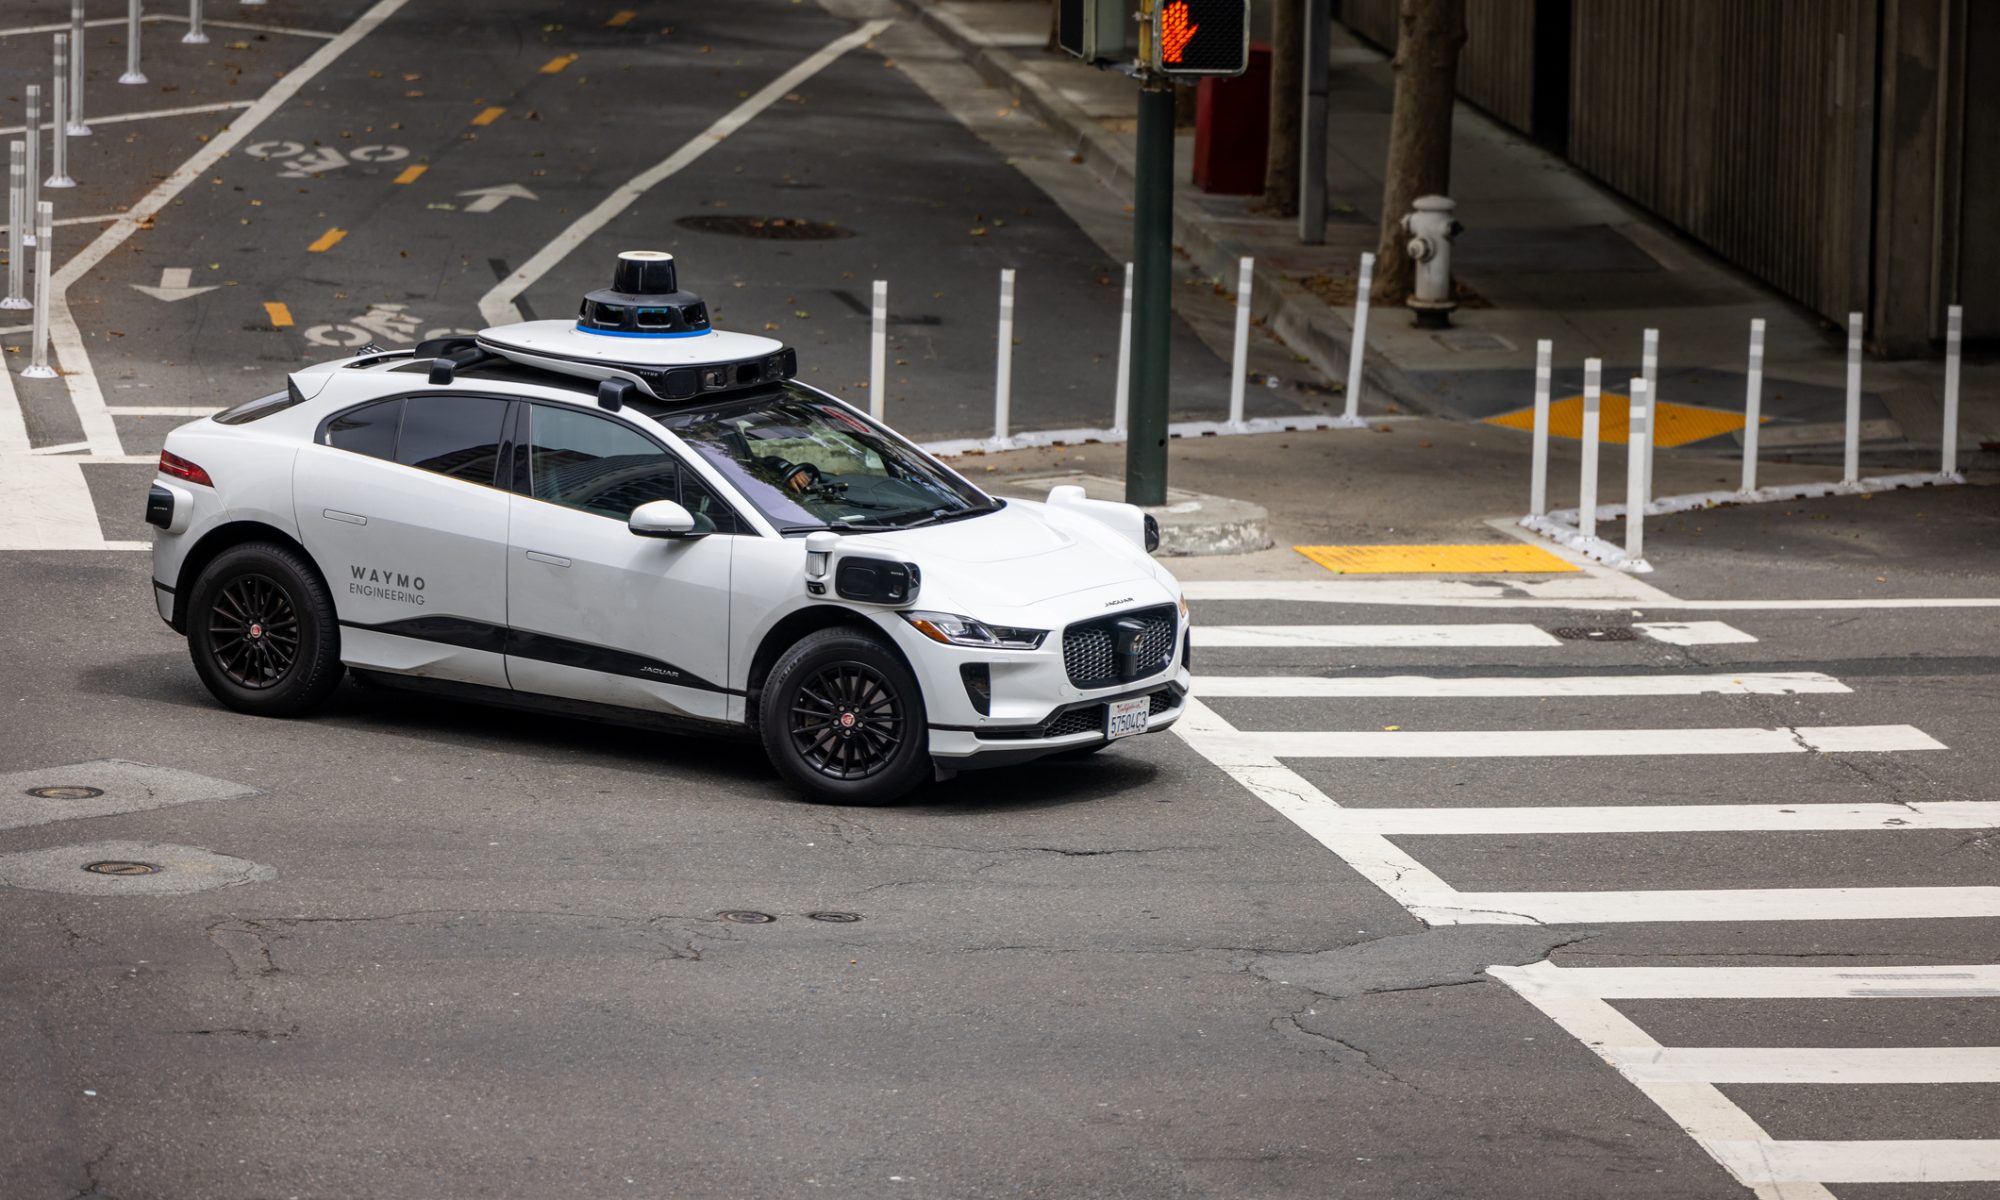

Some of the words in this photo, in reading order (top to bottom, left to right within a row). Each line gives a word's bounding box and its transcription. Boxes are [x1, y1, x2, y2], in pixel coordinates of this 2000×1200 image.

[351, 565, 425, 591] WAYMO
[349, 583, 425, 606] ENGINEERING
[1111, 711, 1147, 733] 57504C3
